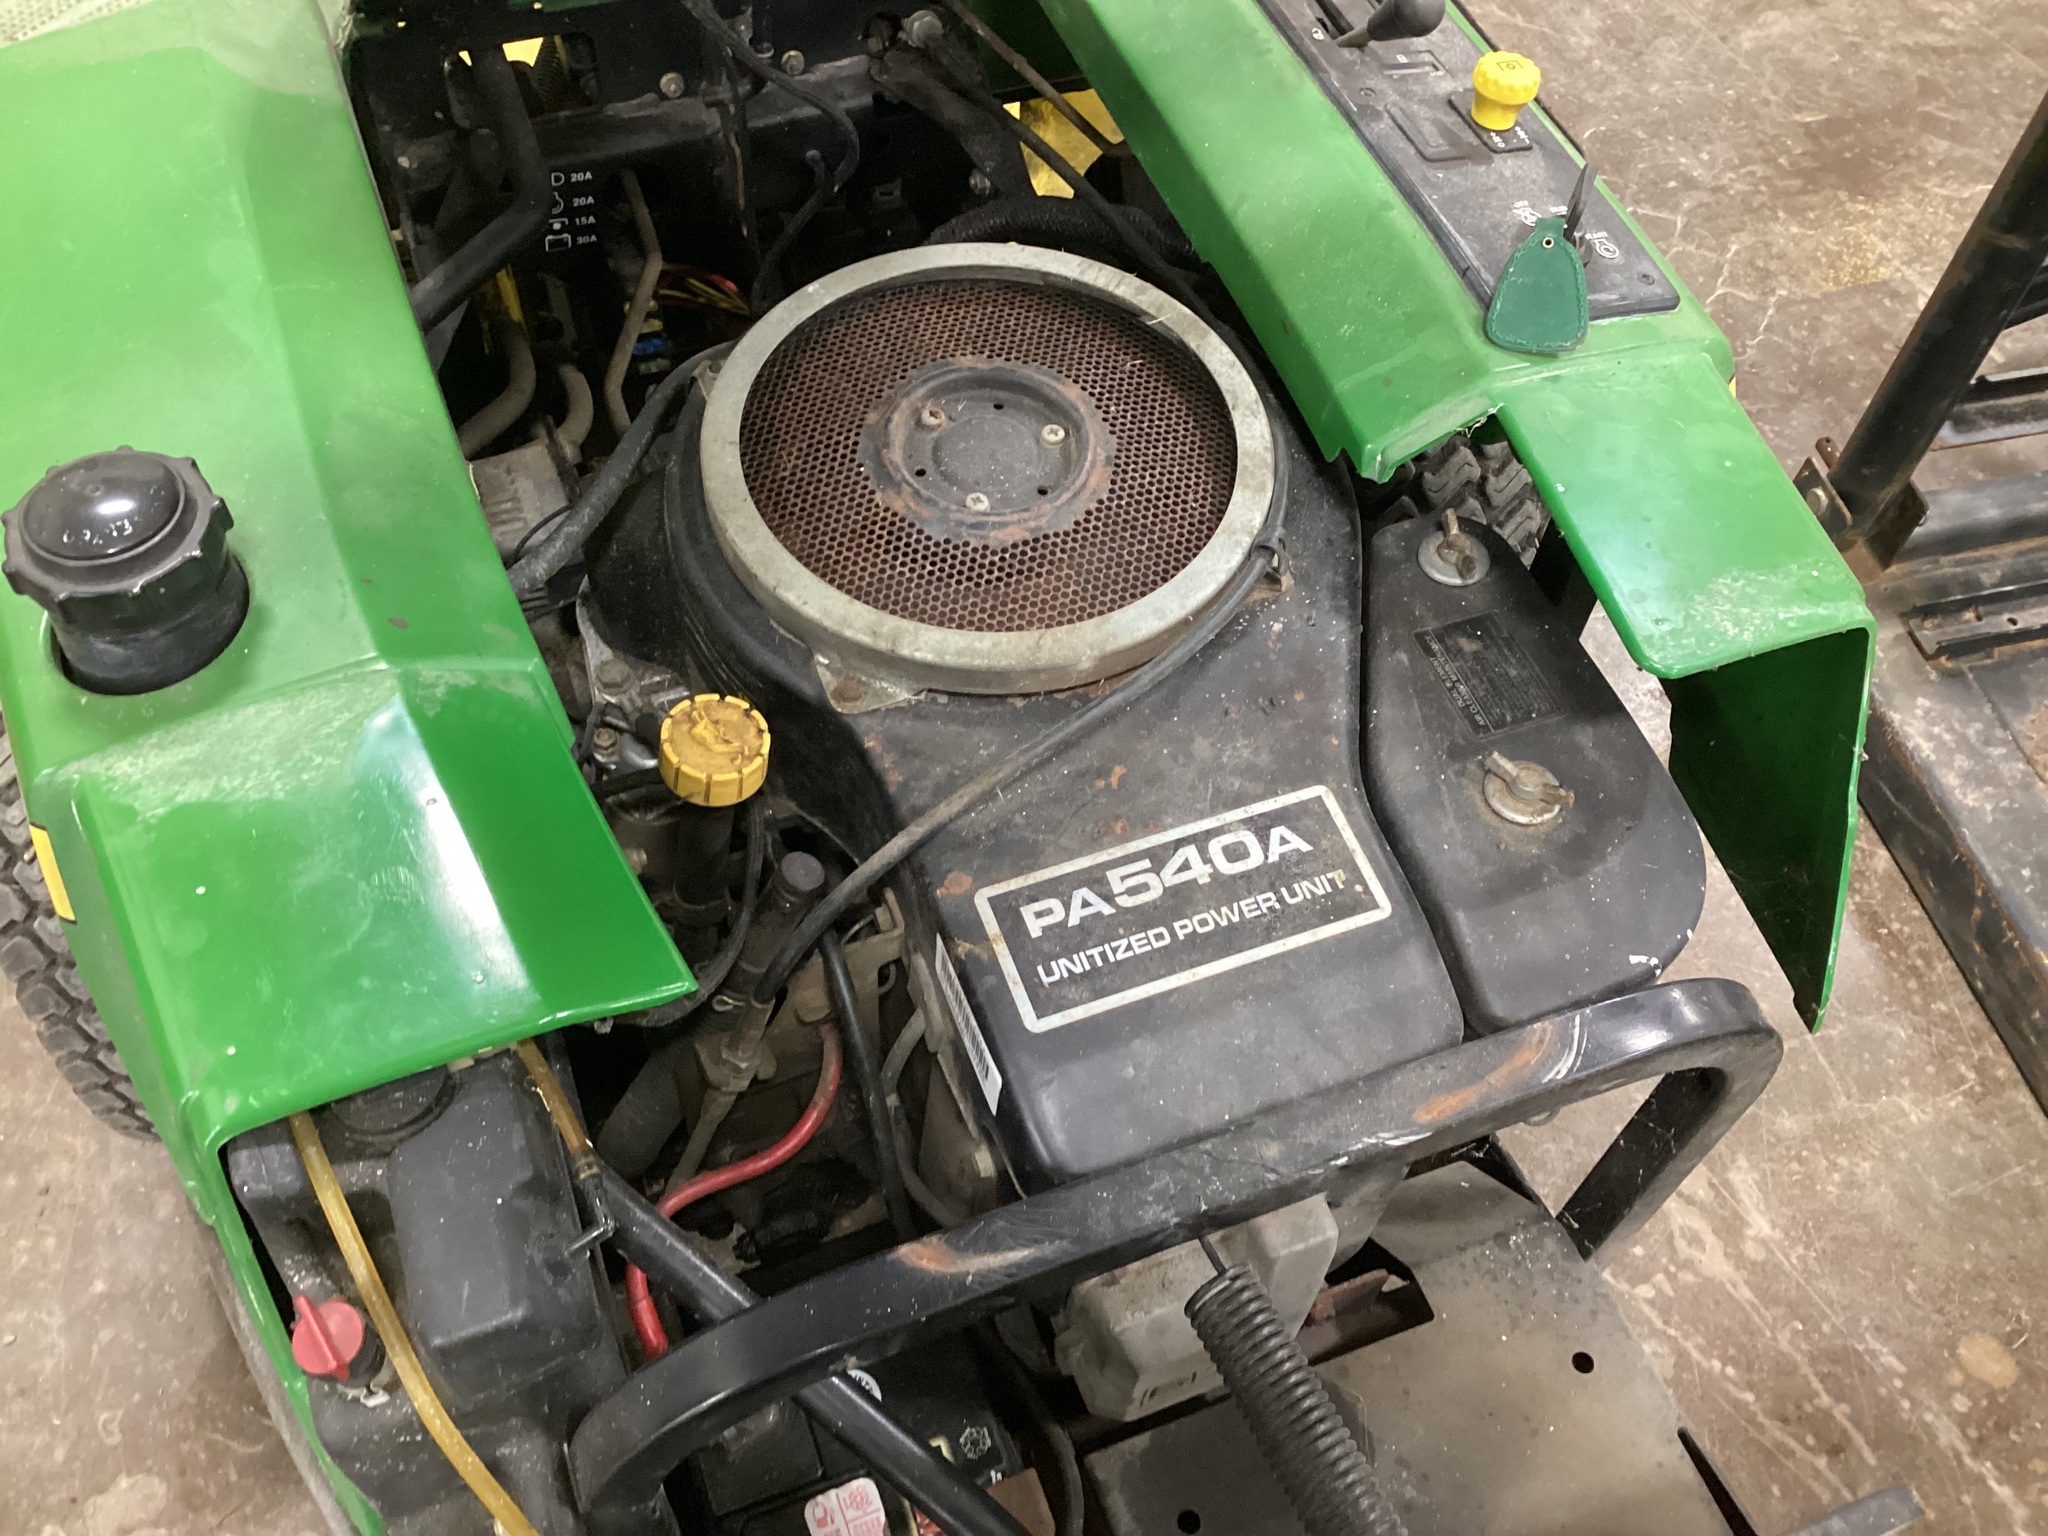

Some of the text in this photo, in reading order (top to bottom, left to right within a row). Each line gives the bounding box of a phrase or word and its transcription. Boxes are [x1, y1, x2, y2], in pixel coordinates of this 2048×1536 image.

[570, 171, 593, 182] 20A
[575, 215, 596, 226] 15A
[1019, 825, 1314, 939] PA540A
[1036, 869, 1348, 985] UNITIZED POWER UNIT
